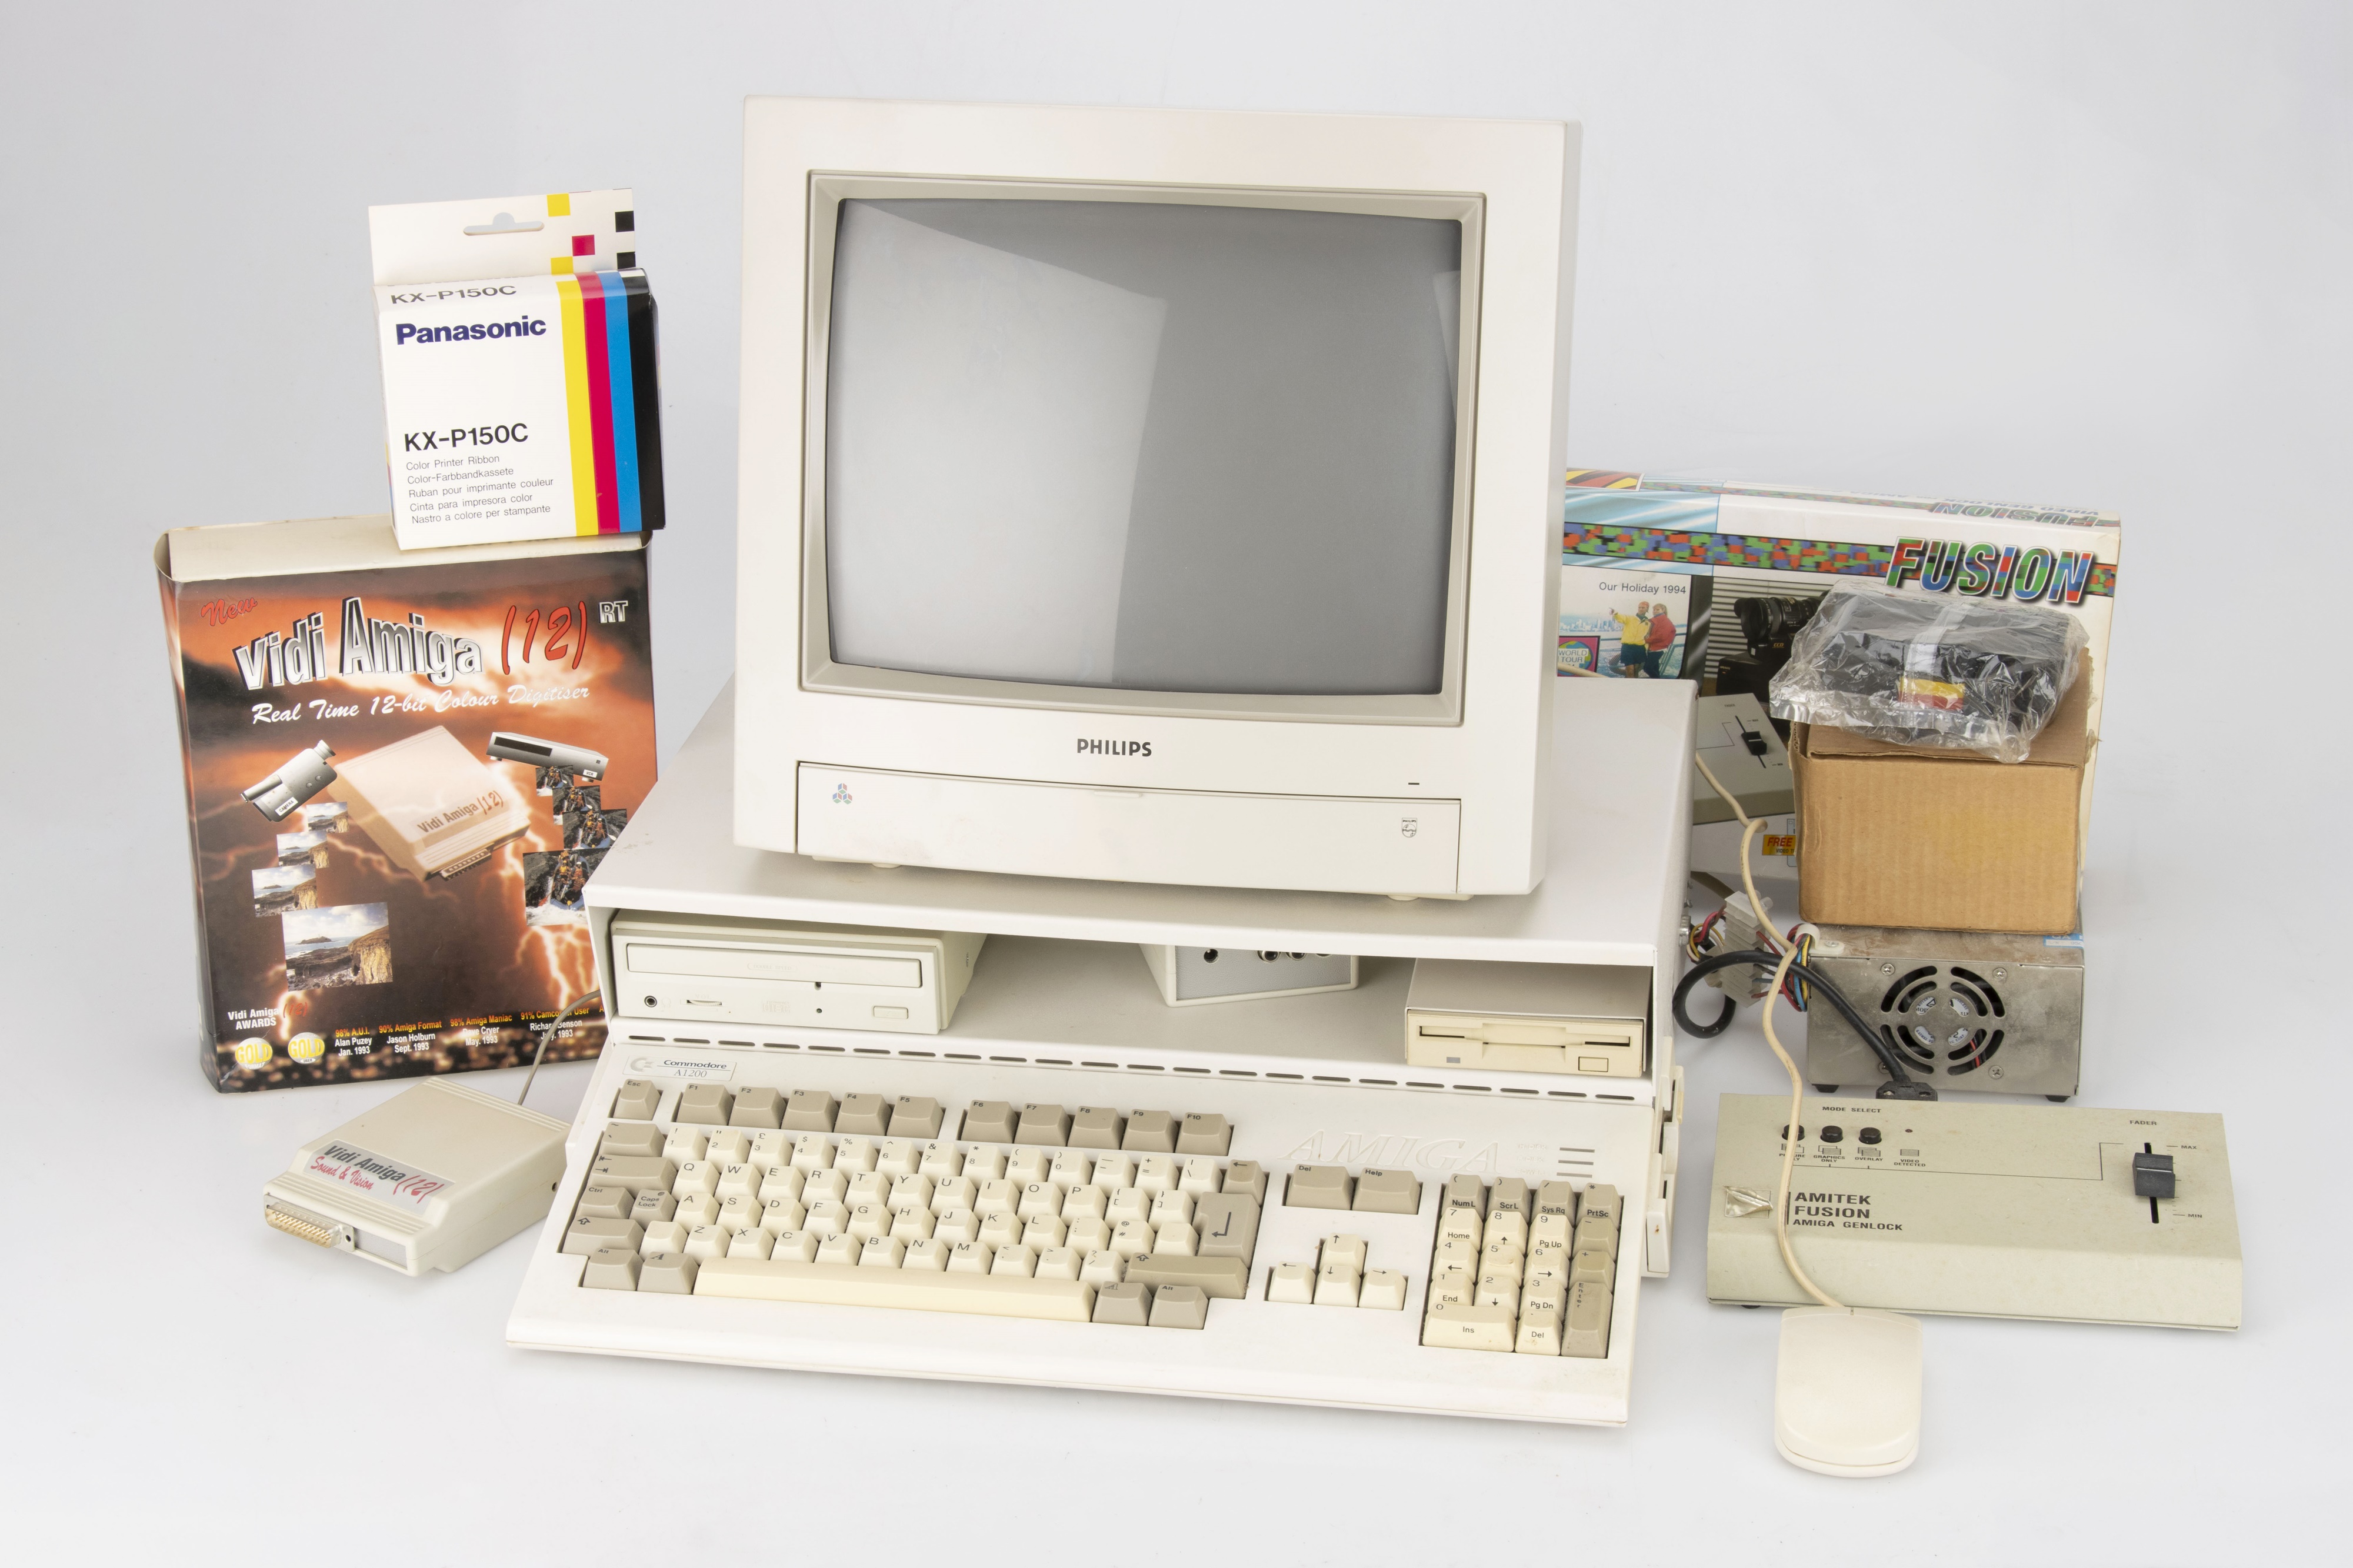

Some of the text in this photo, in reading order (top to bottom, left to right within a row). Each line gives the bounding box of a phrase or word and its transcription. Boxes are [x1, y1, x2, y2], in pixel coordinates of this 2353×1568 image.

[391, 285, 516, 304] KX-P150C
[396, 315, 546, 345] Panasonic
[404, 423, 528, 451] KX-P150C
[406, 455, 499, 470] Color Printer Ribbon
[408, 468, 514, 484] Color-Farbbandkassete
[409, 478, 554, 498] Ruban pour imprimante couleur
[410, 494, 532, 511] Cinta para impresora color
[412, 515, 441, 523] Nastro
[454, 511, 482, 520] colore
[486, 510, 500, 519] per
[504, 505, 551, 515] stampante
[1931, 502, 2099, 528] FUSION
[2040, 506, 2099, 516] VIDEO
[1885, 536, 2093, 603] FUSION
[1599, 582, 1686, 595] Our Holiday 1994
[201, 597, 257, 627] New
[232, 596, 628, 690] Vidi Amiga (12) RT
[252, 685, 589, 724] Real Time 12-bit Colour Digitiser
[1077, 739, 1152, 757] PHILIPS
[279, 800, 294, 812] CAMERA
[417, 790, 504, 833] Vidi Amiga (12)
[1767, 838, 1793, 846] FREE
[228, 1002, 308, 1020] Vidi Amiga (12)
[521, 1011, 534, 1020] 91%
[235, 1017, 276, 1030] AWARDS
[379, 1020, 442, 1033] 90% Amiga Format
[450, 1015, 512, 1027] 98% Amiga Maniac
[530, 1022, 552, 1030] Richar
[335, 1026, 369, 1037] 98% A.U.I.
[409, 1033, 435, 1042] Holburn
[463, 1026, 499, 1036] Dave Cryer
[558, 1029, 573, 1038] 1993
[335, 1037, 372, 1047] Alan Puzey
[395, 1042, 429, 1054] Sept. 1993
[465, 1036, 498, 1047] May. 1993
[235, 1043, 272, 1064] GOLD
[288, 1039, 325, 1058] GOLD
[338, 1046, 370, 1056] Jan. 1993
[664, 1059, 726, 1070] Commodore
[674, 1069, 708, 1078] A1200
[1277, 1129, 1502, 1174] AMIGA
[310, 1156, 374, 1192] Sound & Vision
[324, 1146, 444, 1205] Vidi Amiga (12)
[1365, 1169, 1382, 1177] Help
[1795, 1193, 1871, 1205] AMITEK
[1795, 1206, 1869, 1218] FUSION
[1843, 1222, 1902, 1230] GENLOCK
